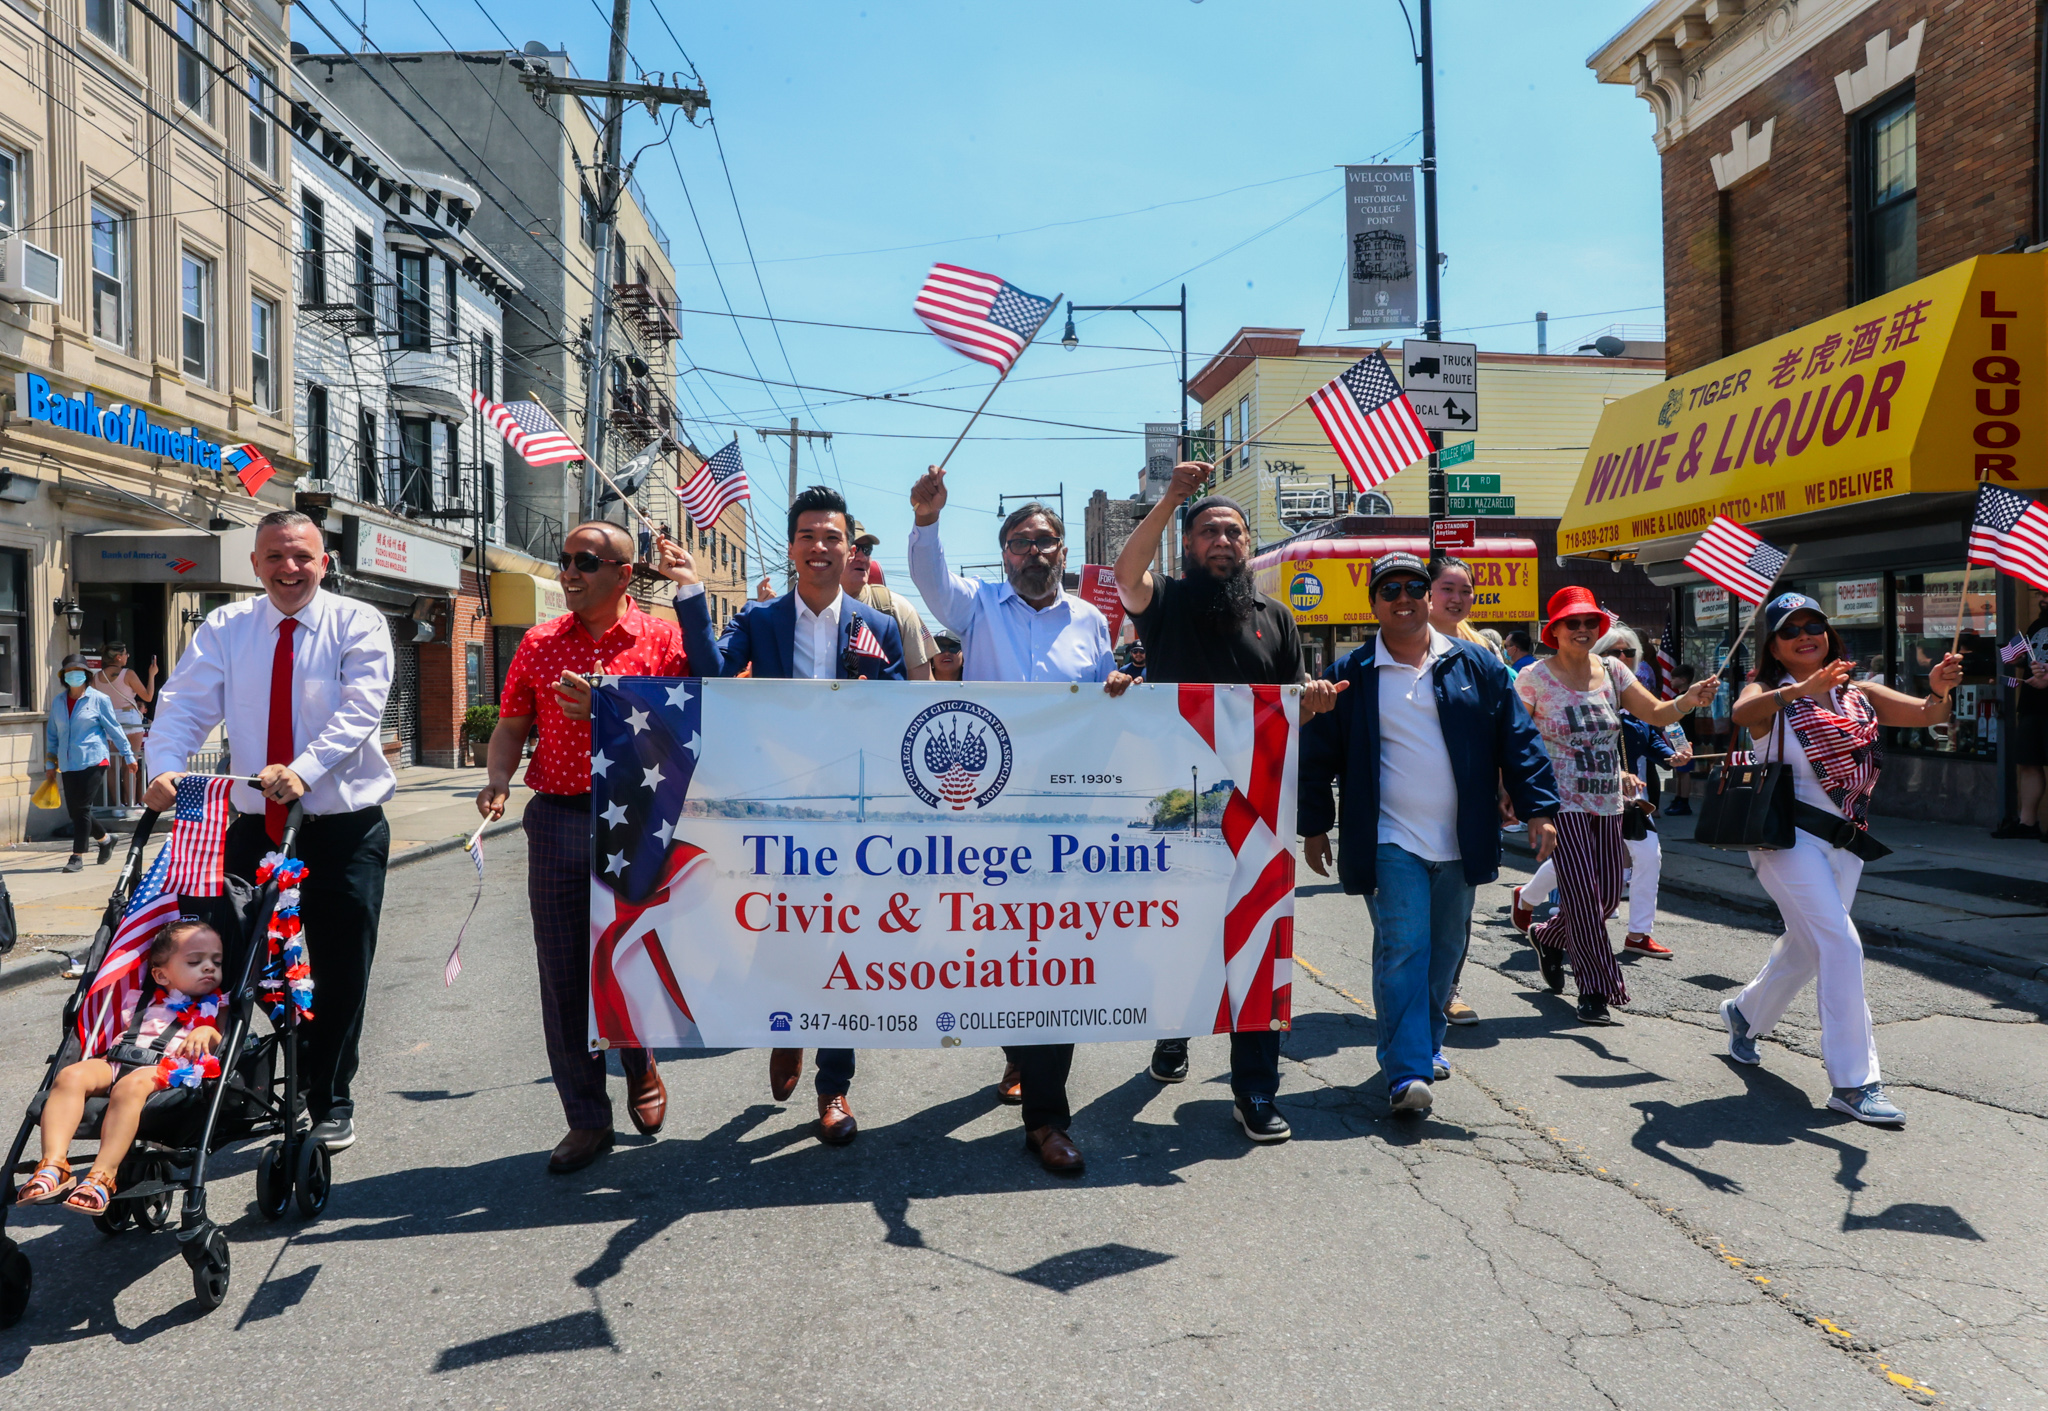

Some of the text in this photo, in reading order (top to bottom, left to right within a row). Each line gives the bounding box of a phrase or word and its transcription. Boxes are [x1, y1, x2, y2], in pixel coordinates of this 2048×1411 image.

[1349, 172, 1412, 182] WELCOME
[1374, 185, 1387, 193] TO
[1354, 195, 1407, 204] HISTORICAL
[1361, 205, 1401, 214] COLLEGE
[1367, 216, 1394, 225] POINT
[1362, 309, 1385, 317] COLLEGE
[1354, 316, 1372, 324] BOARD
[1767, 299, 1933, 389] 老虎酒莊
[1443, 355, 1472, 367] TRUCK
[1443, 374, 1472, 385] ROUTE
[1972, 291, 2021, 481] LIQUOR
[1689, 369, 1751, 411] TIGER
[1415, 404, 1439, 416] OCAL
[26, 372, 222, 472] Bank of America
[1584, 360, 1906, 506] WINE & LIQUOR
[1440, 446, 1459, 462] COLLEGE
[1456, 476, 1470, 491] 14
[1450, 498, 1465, 508] FRED
[1475, 498, 1514, 508] MAZZARELLO
[1566, 524, 1619, 549] 718-939-2738
[1632, 518, 1656, 538] WINE
[1658, 516, 1665, 533] &
[1667, 507, 1707, 531] LIQUOR
[1760, 490, 1786, 514] ATM
[1804, 482, 1825, 506] WE
[1829, 467, 1894, 501] DELIVER
[101, 551, 167, 560] Bank of America
[1304, 577, 1318, 585] NEW
[1305, 585, 1321, 594] YORK
[1291, 594, 1321, 606] LOTTERY
[1294, 614, 1329, 622] -661-1959
[1343, 613, 1358, 621] COLD
[1359, 612, 1374, 621] BEER
[907, 712, 930, 740] POINT
[1591, 732, 1613, 746] but
[902, 741, 919, 788] COLLEGE
[980, 743, 1011, 804] ASSOCIATION
[1050, 774, 1123, 784] EST. 1930's
[915, 786, 935, 805] THE
[742, 833, 1171, 887] The College Point
[735, 892, 1180, 942] Civic & Taxpayers
[821, 947, 1097, 991] Association
[799, 1008, 1147, 1031] 347-460-1058 COLLEGEPOINTCIVIC.COM
